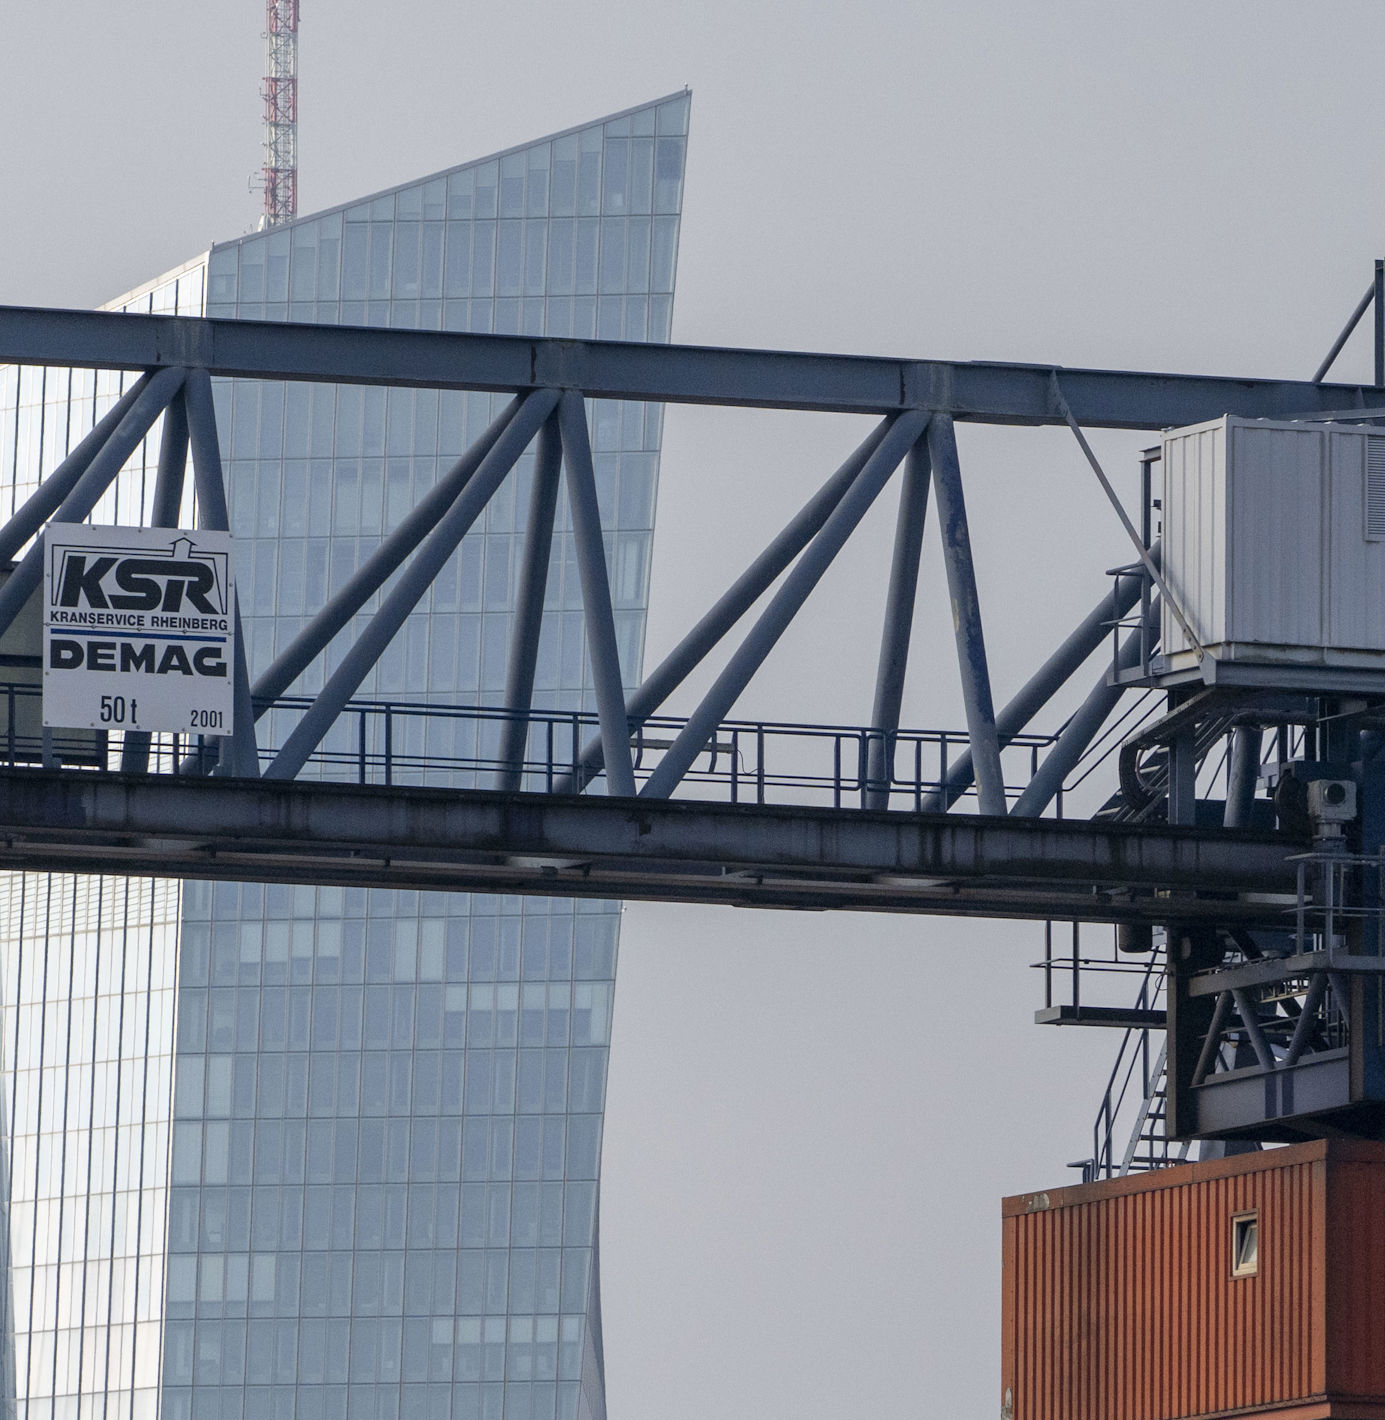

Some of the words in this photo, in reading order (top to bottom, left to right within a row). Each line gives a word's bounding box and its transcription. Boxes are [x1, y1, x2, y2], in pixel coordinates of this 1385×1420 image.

[60, 555, 220, 615] KSR
[50, 611, 145, 627] KRANSERVICE
[151, 616, 228, 631] RHEINBERG
[50, 639, 227, 677] DEMAG
[100, 696, 125, 723] 50
[130, 699, 138, 724] t
[190, 710, 223, 728] 2001
